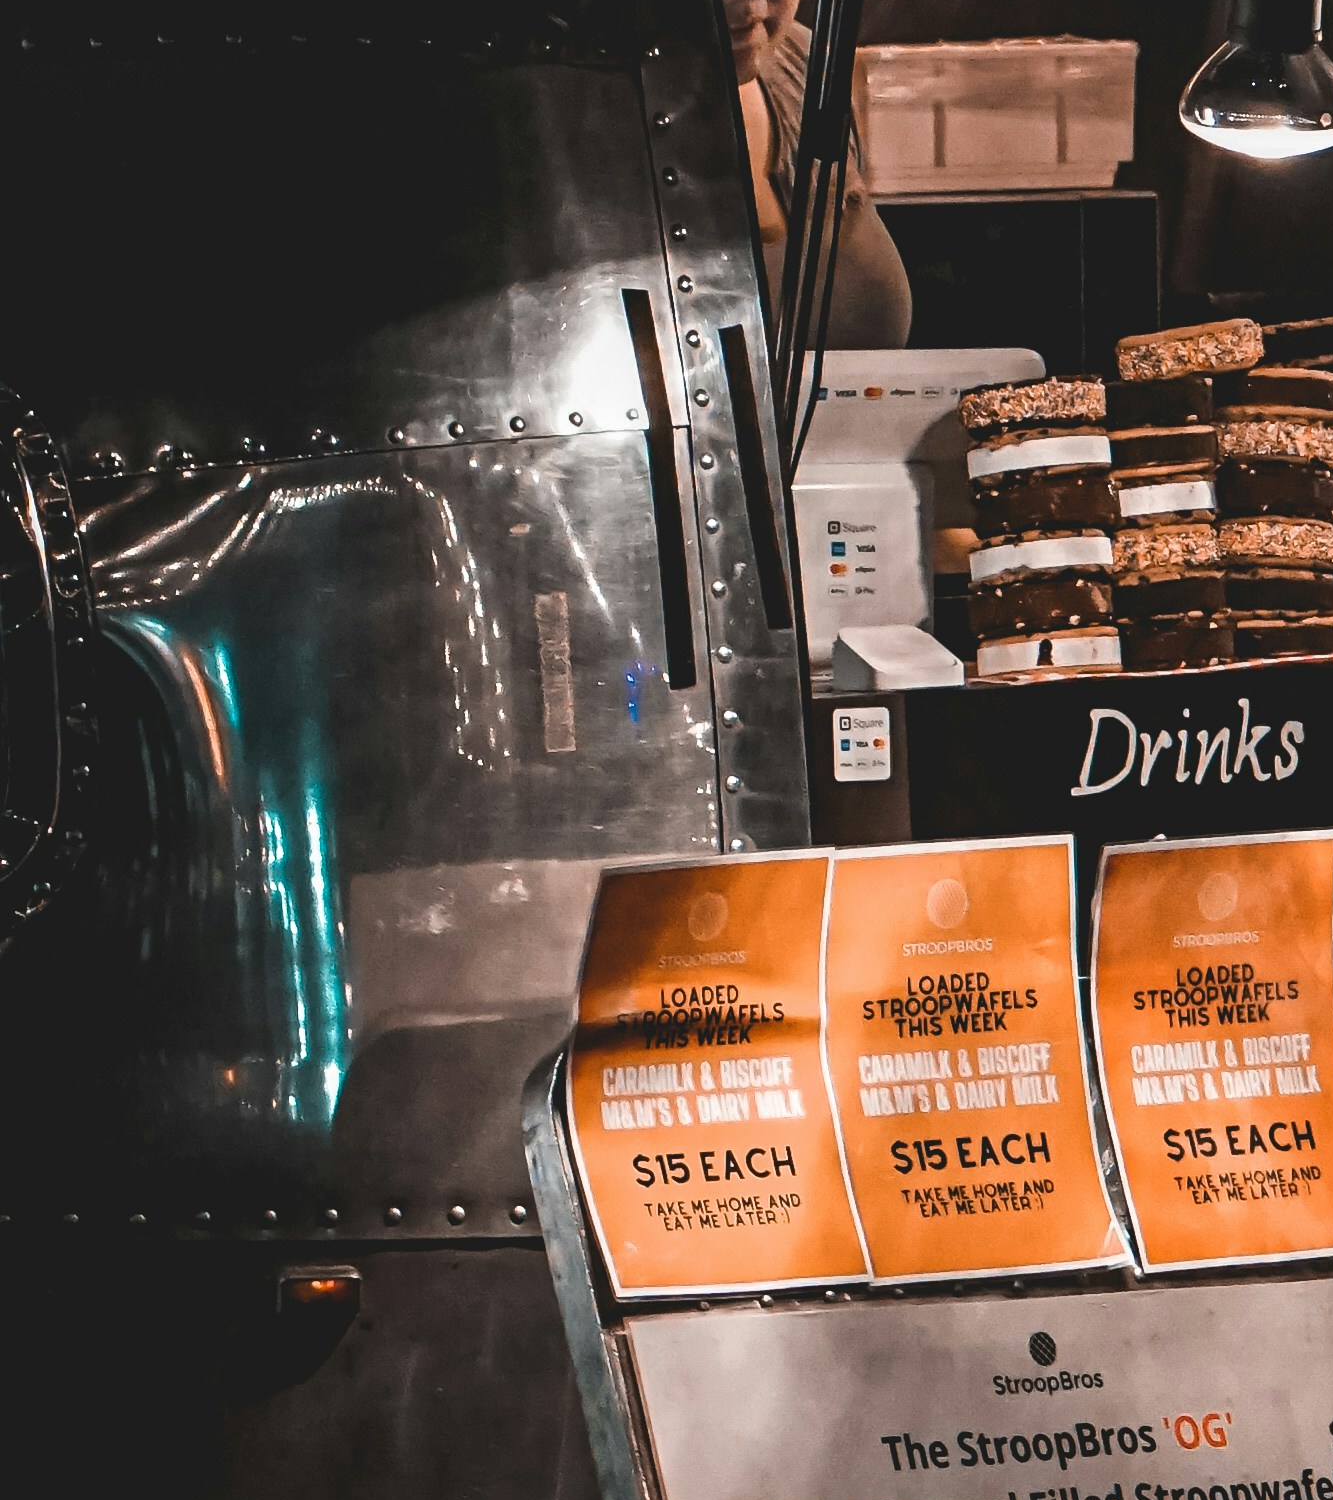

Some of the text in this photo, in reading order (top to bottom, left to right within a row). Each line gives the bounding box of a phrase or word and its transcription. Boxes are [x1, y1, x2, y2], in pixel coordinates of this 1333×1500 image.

[842, 521, 877, 534] Square
[853, 718, 885, 730] Square
[1071, 698, 1304, 796] Drinks
[902, 938, 993, 957] STROOPBROS
[907, 972, 990, 996] LOADED
[1176, 963, 1255, 987] LOADED
[661, 984, 739, 1008] LOADED
[862, 988, 1039, 1021] STROOPWAFELS
[1133, 980, 1300, 1011] STROOPWAFELS
[894, 1012, 1008, 1039] THIS WEEK
[1164, 1002, 1271, 1029] THIS WEEK
[697, 1025, 752, 1046] WEEK
[858, 1042, 1051, 1084] CARAMILK & BISCOFF
[1130, 1033, 1311, 1074] CARAMILK & BISCOFF
[602, 1056, 793, 1096] CARAMILK & BISCOFF
[1132, 1064, 1322, 1106] M&M'S & DAIRY MILK
[860, 1074, 1059, 1117] M&M'S & DAIRY MILK
[600, 1089, 806, 1130] M&M'S & DAIRY MILK
[890, 1132, 1051, 1175] $15 EACH
[1163, 1119, 1317, 1162] $15 EACH
[632, 1146, 797, 1188] $15 EACH
[1174, 1165, 1322, 1191] TAKE ME HOME AND
[644, 1193, 801, 1217] TAKE ME HOME AND
[901, 1179, 1055, 1204] TAKE ME HOME AND
[1191, 1182, 1299, 1205] EAT ME LATER
[663, 1209, 777, 1231] EAT ME LATER
[920, 1195, 1032, 1218] EAT ME LATER
[993, 1368, 1105, 1398] StroopBros
[881, 1432, 950, 1472] The
[956, 1420, 1158, 1471] StroopBros
[1162, 1412, 1233, 1452] 'OG'
